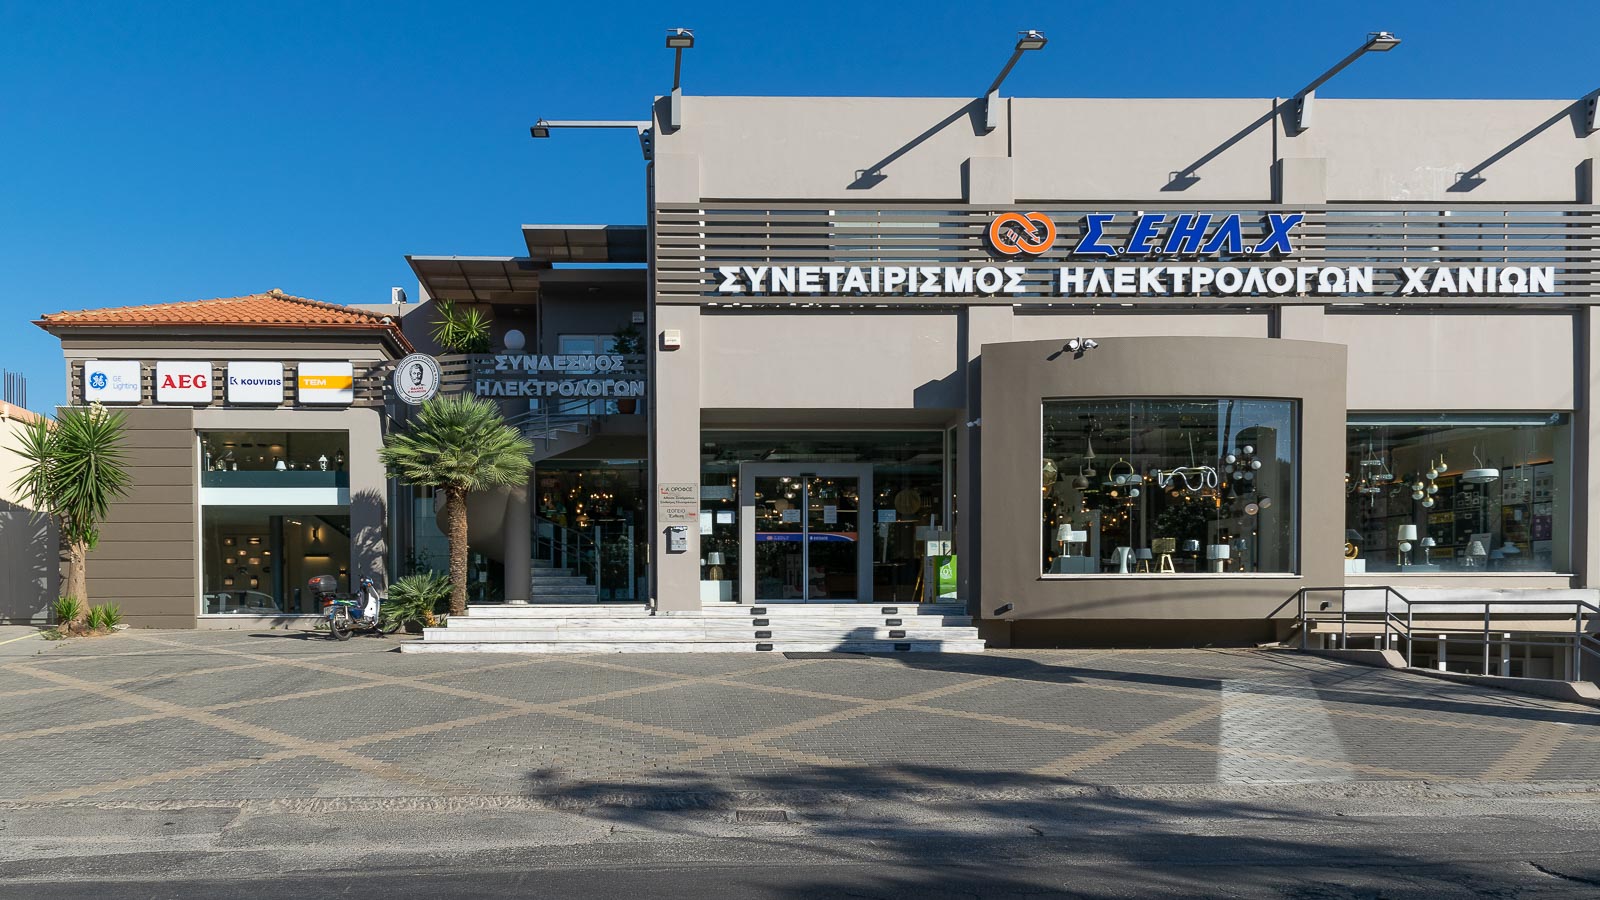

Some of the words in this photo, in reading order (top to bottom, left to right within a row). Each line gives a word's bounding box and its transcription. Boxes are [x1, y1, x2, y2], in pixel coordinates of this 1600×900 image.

[718, 266, 1026, 294] ΣΥΝΕΤΑΙΡΙΣΜΟΣ
[1059, 266, 1374, 294] ΗΛΕΚΤΡΟΛΟΓΩΝ
[1400, 266, 1556, 294] ΧΑΝΙΩΝ
[495, 355, 625, 371] ΣΥΝΔΕΣΜΟΣ
[112, 383, 138, 391] Lighting
[161, 374, 207, 389] AEG
[476, 381, 645, 396] ΗΛΕΚΤΡΟΛΟΓΩΝ
